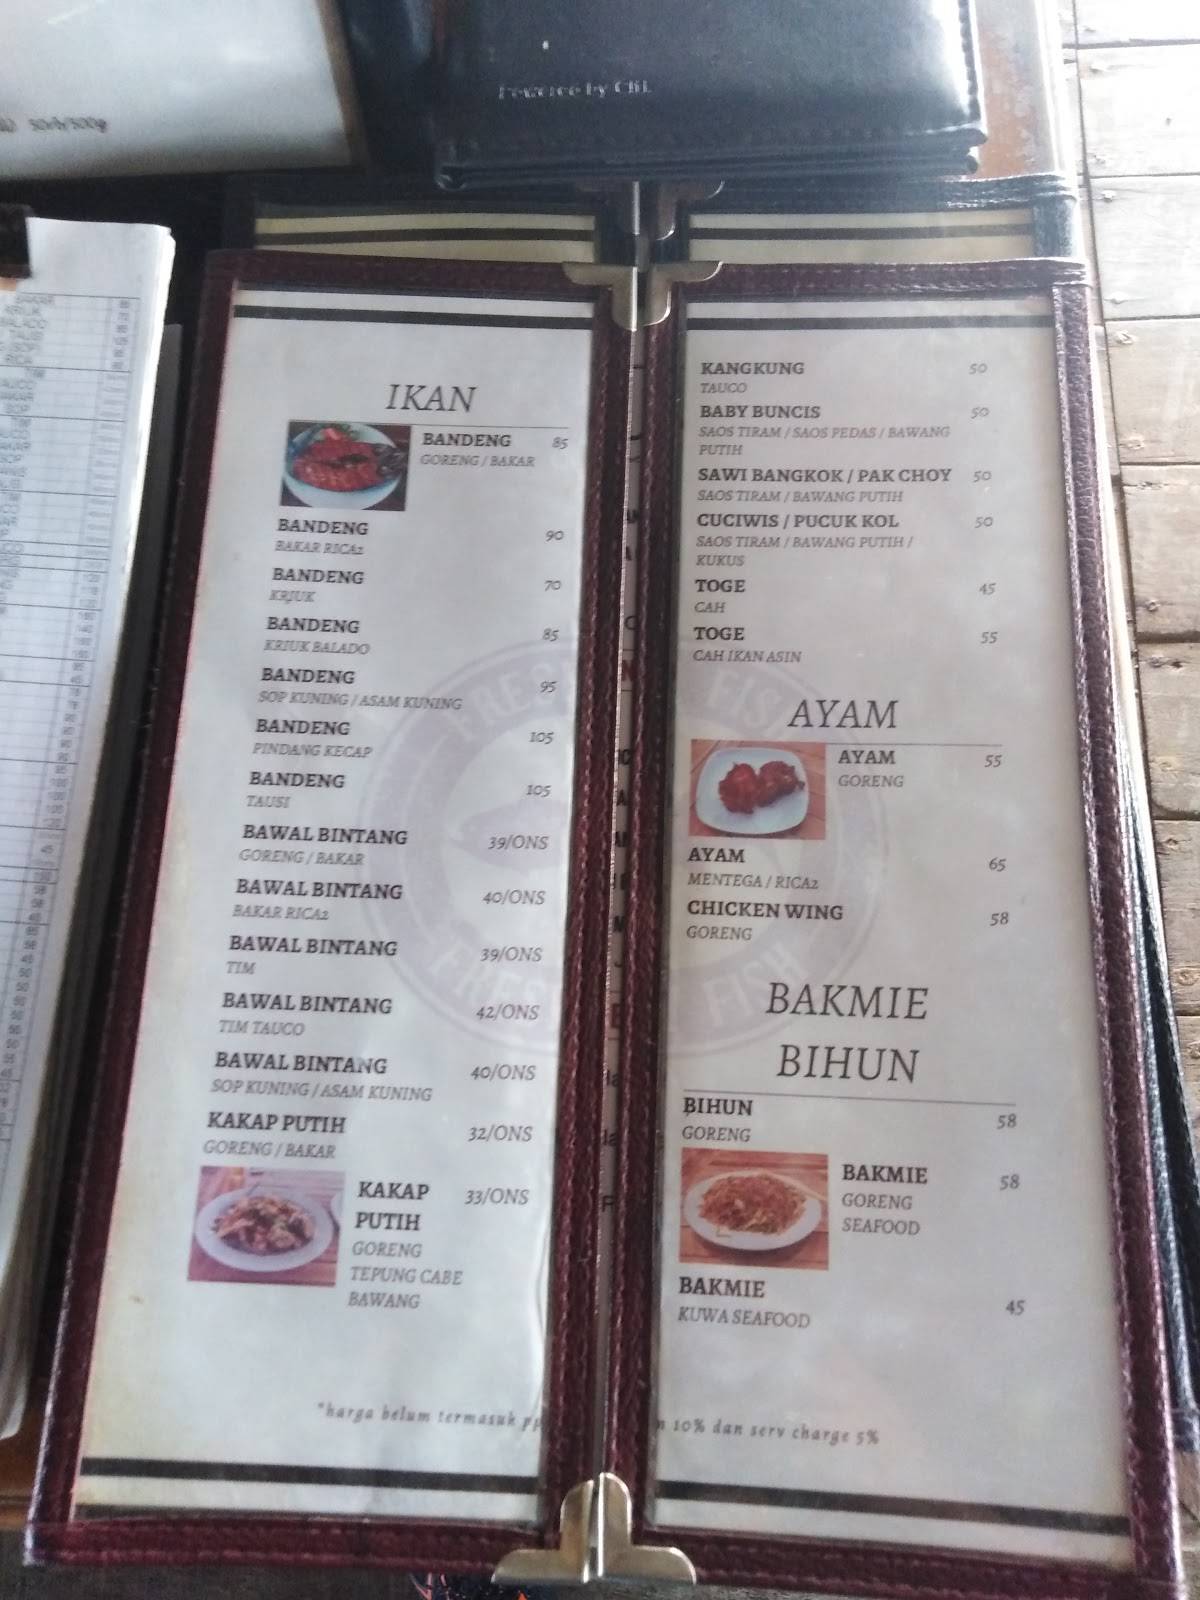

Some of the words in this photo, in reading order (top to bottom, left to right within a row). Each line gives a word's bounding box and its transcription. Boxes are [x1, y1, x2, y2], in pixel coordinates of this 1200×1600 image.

[701, 362, 805, 375] KANGKUNG
[969, 363, 988, 375] 50
[700, 383, 747, 393] TAUCO
[386, 384, 476, 413] IKAN
[700, 406, 749, 418] BABY
[752, 406, 820, 418] BUNCIS
[971, 407, 990, 419] 50
[422, 433, 511, 447] BANDENG
[699, 427, 735, 437] SAOS
[737, 427, 782, 438] TIRAM
[792, 428, 829, 438] SAOS
[831, 428, 877, 438] PEDAS
[887, 427, 950, 438] BAWANG
[552, 436, 568, 449] 85
[699, 445, 743, 456] PUTIH
[421, 454, 479, 466] GORENG
[490, 455, 535, 467] BAKAR
[698, 468, 747, 481] SAWI
[752, 469, 843, 482] BANGKOK
[857, 469, 894, 482] PAK
[898, 469, 952, 482] CHOY
[973, 471, 991, 482] 50
[697, 490, 733, 501] SAOS
[736, 491, 781, 501] TIRAM
[793, 491, 856, 502] BAWANG
[858, 491, 903, 502] PUTIH
[277, 519, 369, 535] BANDENG
[697, 514, 779, 528] CUCIWIS
[794, 515, 857, 528] PUCUK
[862, 515, 899, 528] KOL
[975, 517, 993, 529] 50
[546, 530, 564, 542] 90
[696, 537, 733, 547] SAOS
[735, 537, 781, 548] TIRAM
[793, 537, 856, 548] BAWANG
[858, 537, 905, 548] PUTIH
[275, 541, 321, 553] BAKAR
[696, 555, 745, 566] KUKUS
[272, 568, 364, 584] BANDENG
[545, 580, 561, 591] 70
[695, 580, 745, 592] TOGE
[979, 583, 996, 596] 45
[695, 602, 725, 613] CAH
[268, 617, 359, 633] BANDENG
[543, 629, 559, 641] 85
[694, 627, 745, 640] TOGE
[980, 632, 998, 644] 55
[313, 642, 370, 654] BALADO
[693, 650, 724, 661] CAH
[728, 651, 764, 662] IKAN
[766, 651, 802, 663] ASIN
[262, 668, 355, 684] BANDENG
[540, 681, 557, 693] 95
[258, 691, 287, 704] SOP
[290, 692, 349, 706] KUNING
[359, 694, 401, 707] ASAM
[402, 696, 463, 710] KUNING
[788, 700, 898, 729] AYAM
[256, 719, 351, 735] BANDENG
[530, 732, 554, 744] 105
[253, 743, 322, 757] PINDANG
[324, 745, 373, 758] KECAP
[838, 750, 896, 764] AYAM
[984, 755, 1002, 768] 55
[250, 772, 345, 788] BANDENG
[838, 775, 904, 787] GORENG
[527, 784, 551, 797] 105
[247, 795, 291, 808] TAUSI
[243, 825, 313, 841] BAWAL
[318, 827, 408, 845] BINTANG
[488, 835, 550, 850] 39/ONS
[239, 849, 304, 863] GORENG
[316, 852, 365, 865] BAKAR
[688, 849, 745, 863] AYAM
[989, 858, 1006, 871] 65
[688, 874, 762, 888] MENTEGA
[236, 879, 308, 896] BAWAL
[312, 882, 402, 900] BINTANG
[483, 890, 546, 905] 40/ONS
[232, 905, 282, 919] BAKAR
[687, 900, 780, 917] CHICKEN
[784, 905, 843, 920] WING
[990, 912, 1009, 926] 58
[686, 926, 752, 940] GORENG
[230, 936, 302, 953] BAWAL
[307, 939, 398, 956] BINTANG
[480, 947, 543, 963] 39/ONS
[227, 962, 256, 974] TIM
[222, 993, 295, 1011] BAWAL
[300, 996, 393, 1014] BINTANG
[766, 982, 930, 1020] BAKMIE
[477, 1005, 539, 1021] 42/ONS
[219, 1020, 250, 1034] TIM
[253, 1021, 305, 1036] TAUCO
[215, 1052, 289, 1070] BAWAL
[294, 1055, 388, 1074] BINTANG
[777, 1045, 919, 1083] BIHUN
[470, 1064, 536, 1081] 40/ONS
[211, 1079, 243, 1093] SOP
[245, 1080, 310, 1097] KUNING
[320, 1084, 364, 1098] ASAM
[368, 1086, 432, 1102] KUNING
[683, 1097, 753, 1116] BIHUN
[208, 1112, 278, 1131] KAKAP
[282, 1116, 346, 1133] PUTIH
[997, 1114, 1017, 1129] 58
[468, 1126, 533, 1142] 32/ONS
[682, 1126, 751, 1142] GORENG
[204, 1141, 273, 1156] GORENG
[285, 1144, 336, 1159] BAKAR
[842, 1165, 928, 1184] BAKMIE
[358, 1181, 430, 1200] KAKAP
[1000, 1176, 1020, 1191] 58
[465, 1189, 529, 1206] 33/ONS
[842, 1193, 913, 1209] GORENG
[356, 1212, 421, 1231] PUTIH
[842, 1218, 920, 1235] SEAFOOD
[352, 1242, 422, 1258] GORENG
[350, 1267, 418, 1284] TEPUNG
[421, 1269, 464, 1285] CABE
[680, 1277, 765, 1298] BAKMIE
[348, 1292, 420, 1309] BAWANG
[1005, 1300, 1025, 1316] 45
[678, 1307, 729, 1323] KUWA
[731, 1309, 810, 1328] SEAFOOD
[381, 1406, 431, 1423] belum
[438, 1411, 515, 1426] termasuk
[674, 1419, 705, 1433] 10%
[713, 1419, 743, 1435] dan
[750, 1426, 785, 1437] serv
[792, 1424, 850, 1445] charge
